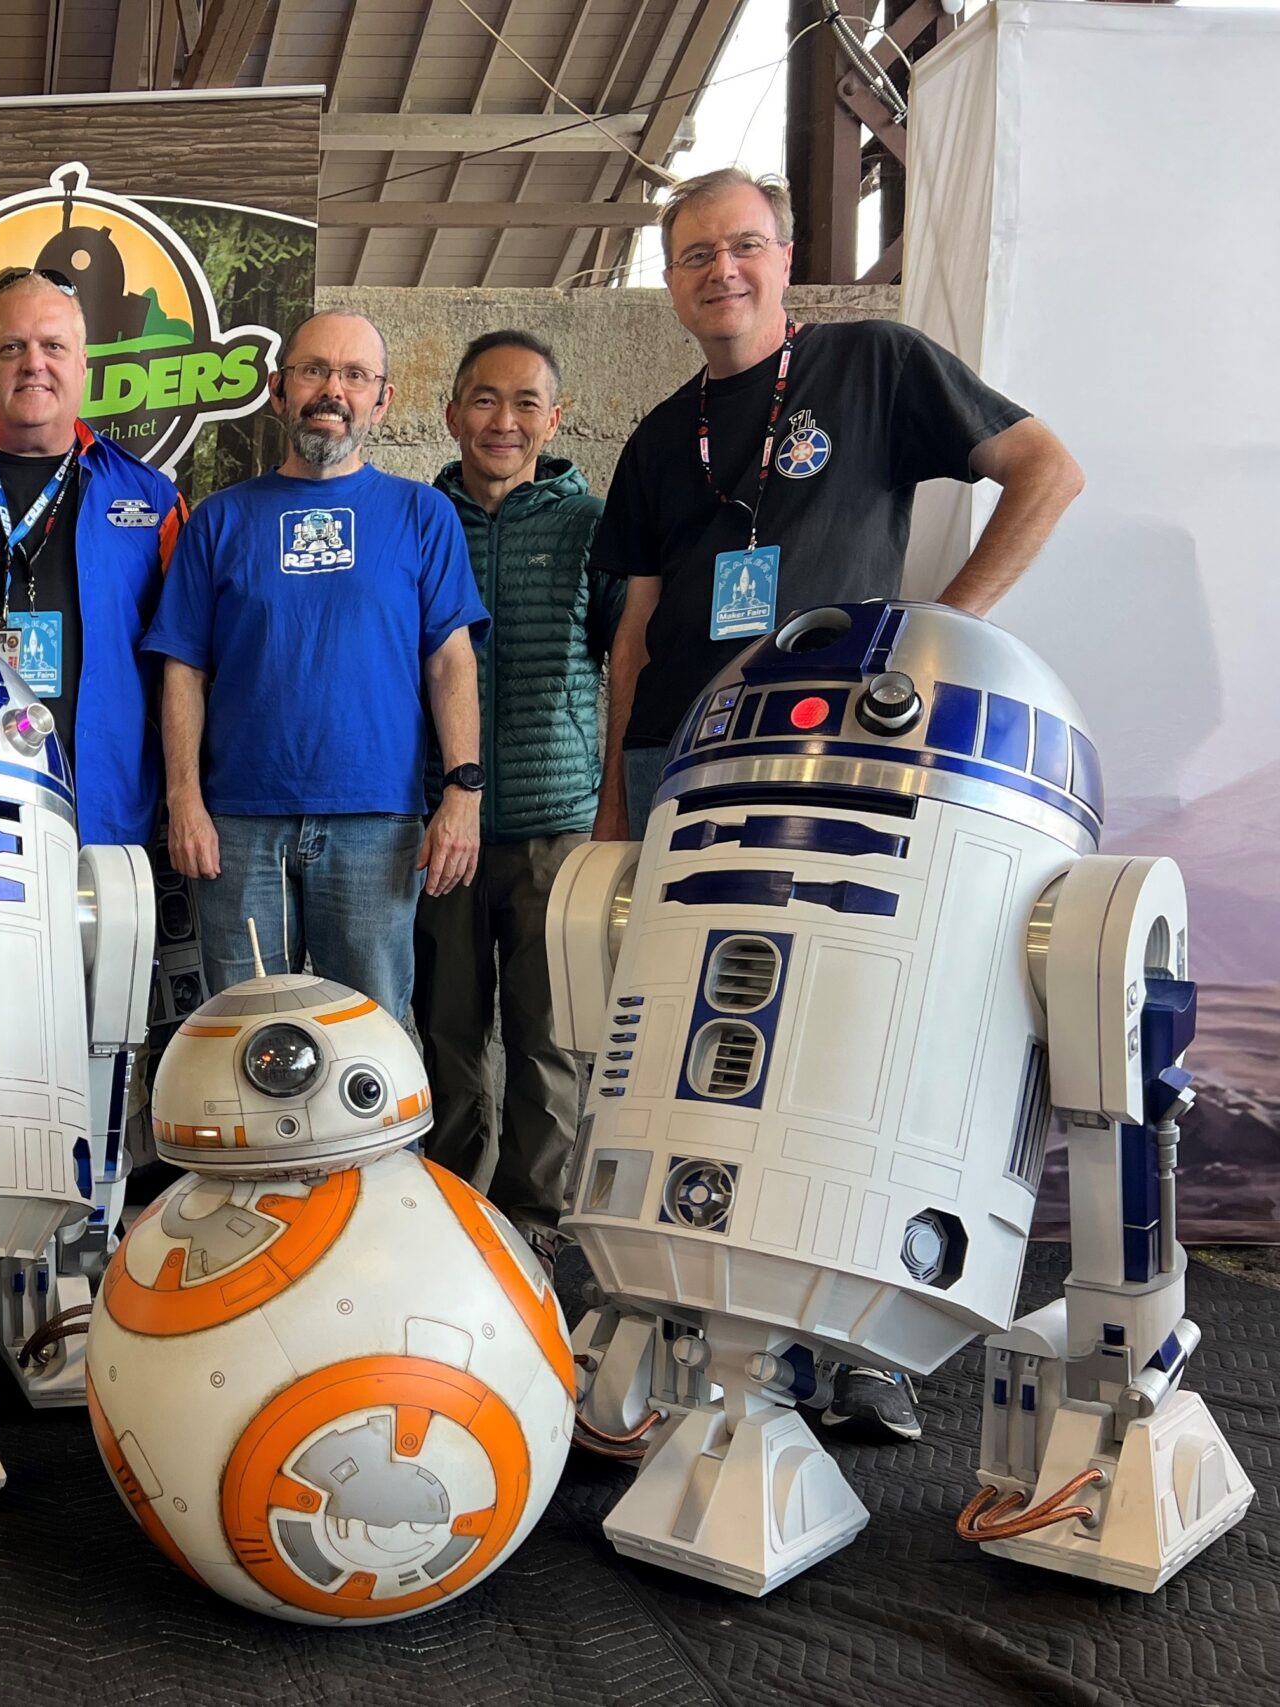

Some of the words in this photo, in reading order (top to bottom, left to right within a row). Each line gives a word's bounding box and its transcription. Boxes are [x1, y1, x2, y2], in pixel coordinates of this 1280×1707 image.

[24, 492, 49, 527] CREW
[283, 549, 352, 568] R2-D2
[719, 612, 745, 621] Maker
[747, 608, 767, 617] Faire
